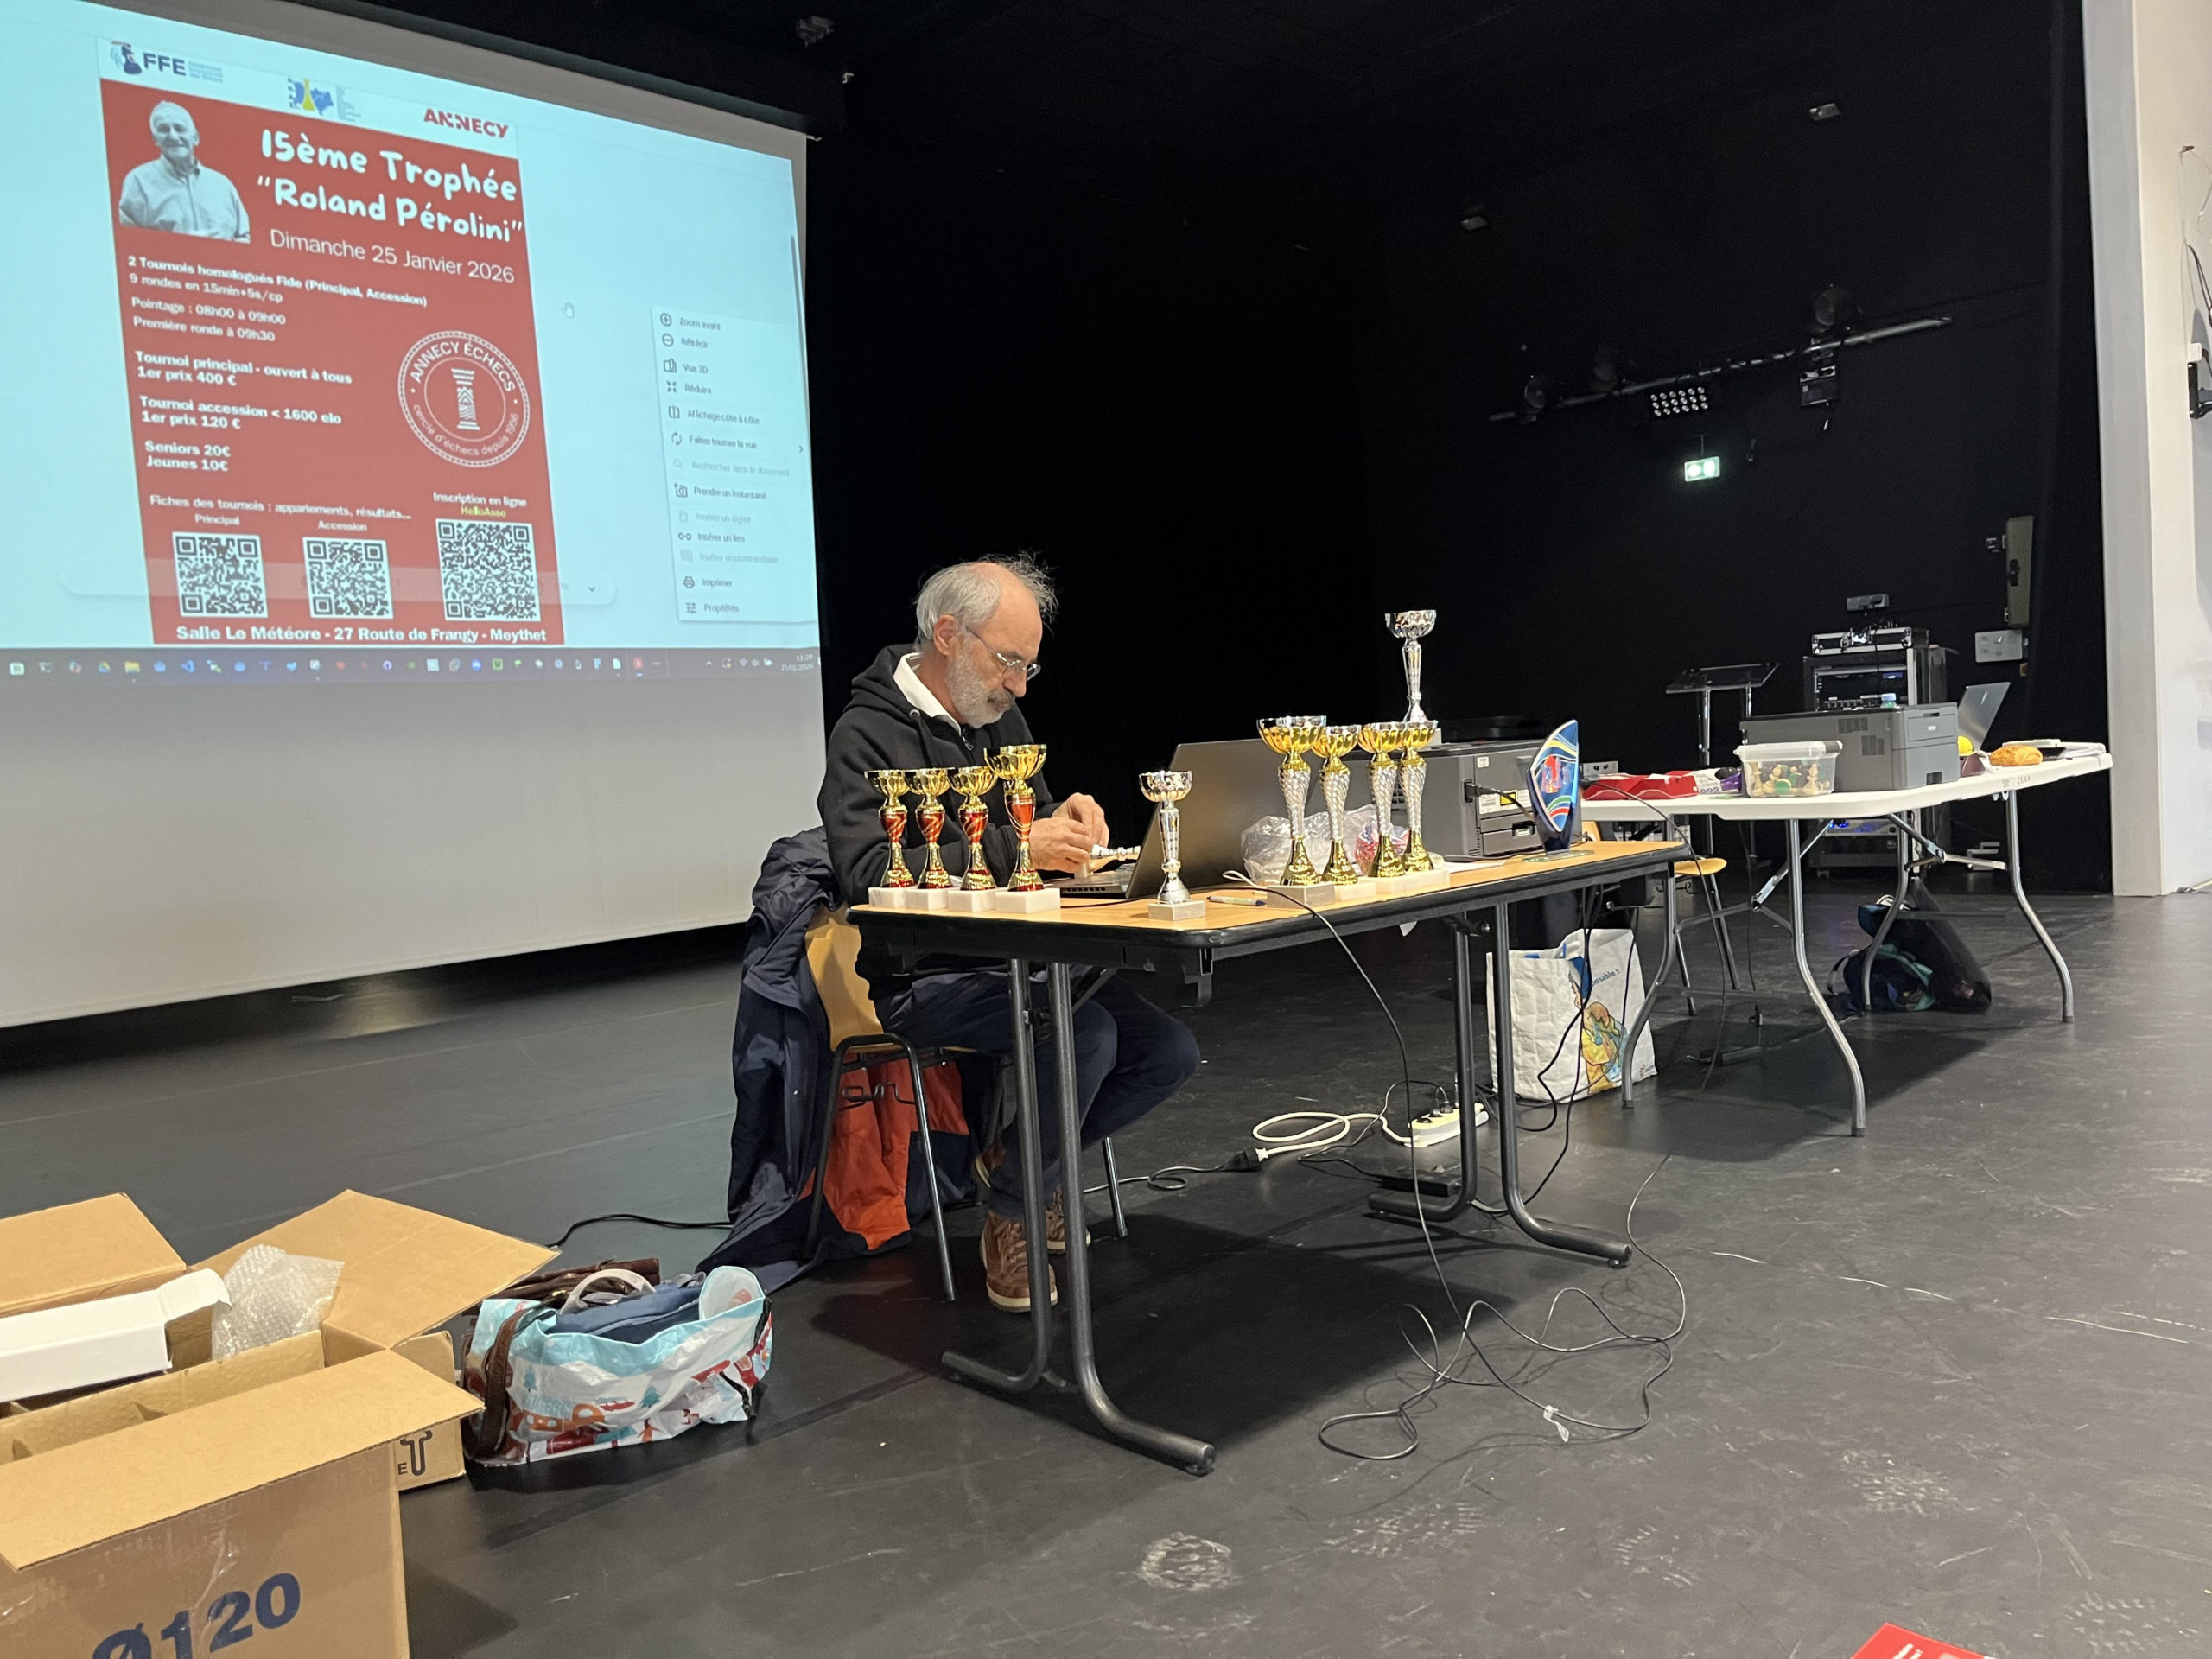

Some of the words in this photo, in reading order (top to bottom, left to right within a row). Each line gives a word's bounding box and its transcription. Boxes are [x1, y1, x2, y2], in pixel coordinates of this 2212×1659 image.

[143, 52, 187, 76] FFE
[423, 108, 508, 138] ANNECY
[262, 129, 367, 174] 15ème
[379, 150, 517, 201] Trophée
[270, 228, 365, 260] Dimanche
[371, 245, 397, 264] 25
[403, 250, 463, 275] Janvier
[467, 260, 515, 283] 2026
[128, 256, 136, 267] 2
[139, 257, 194, 274] Tournois
[198, 264, 274, 284] homologués
[276, 274, 302, 289] Fide
[305, 279, 363, 298] (Principal,
[366, 288, 427, 308] Accession)
[130, 273, 138, 283] 9
[142, 276, 181, 289] rondes
[185, 282, 200, 292] en
[131, 296, 185, 315] Pointage
[195, 304, 235, 319] 08h00
[238, 309, 245, 321] à
[248, 310, 286, 325] 09h00
[133, 315, 187, 332] Première
[190, 323, 223, 336] ronde
[226, 327, 234, 338] à
[237, 327, 276, 342] 09h30
[679, 317, 701, 328] Zoom
[135, 350, 189, 366] Tournoi
[193, 357, 253, 374] principal
[264, 366, 308, 380] ouvert
[311, 368, 320, 381] à
[322, 370, 353, 384] tous
[137, 365, 162, 378] 1er
[165, 369, 193, 383] prix
[196, 371, 224, 385] 400
[227, 374, 237, 386] €
[410, 341, 460, 384] ANNECY
[464, 340, 516, 391] ÉCHECS
[683, 363, 697, 373] Vue
[139, 395, 194, 411] Tournoi
[198, 402, 268, 418] accession
[271, 410, 280, 418] <
[283, 408, 318, 423] 1600
[321, 412, 342, 424] elo
[142, 410, 166, 423] 1er
[169, 414, 197, 427] prix
[201, 415, 228, 429] 120
[232, 417, 241, 429] €
[412, 404, 435, 435] cercle
[481, 435, 510, 456] depuis
[144, 440, 200, 455] Seniors
[204, 444, 231, 457] 20€
[146, 455, 198, 469] Jeunes
[201, 458, 228, 472] 10€
[149, 494, 190, 507] Fiches
[193, 497, 214, 508] des
[218, 499, 264, 512] tournois
[275, 503, 353, 518] appariements,
[433, 491, 486, 505] Inscription
[488, 496, 501, 505] en
[503, 495, 527, 509] ligne
[195, 513, 240, 526] Principal
[460, 505, 507, 518] HelloAsso
[318, 520, 367, 532] Accession
[176, 626, 221, 639] Salle
[226, 626, 246, 639] Le
[251, 626, 321, 640] Météore
[334, 626, 353, 640] 27
[358, 627, 404, 641] Route
[408, 627, 427, 641] de
[431, 628, 479, 644] Frangy
[490, 628, 547, 644] Meythet
